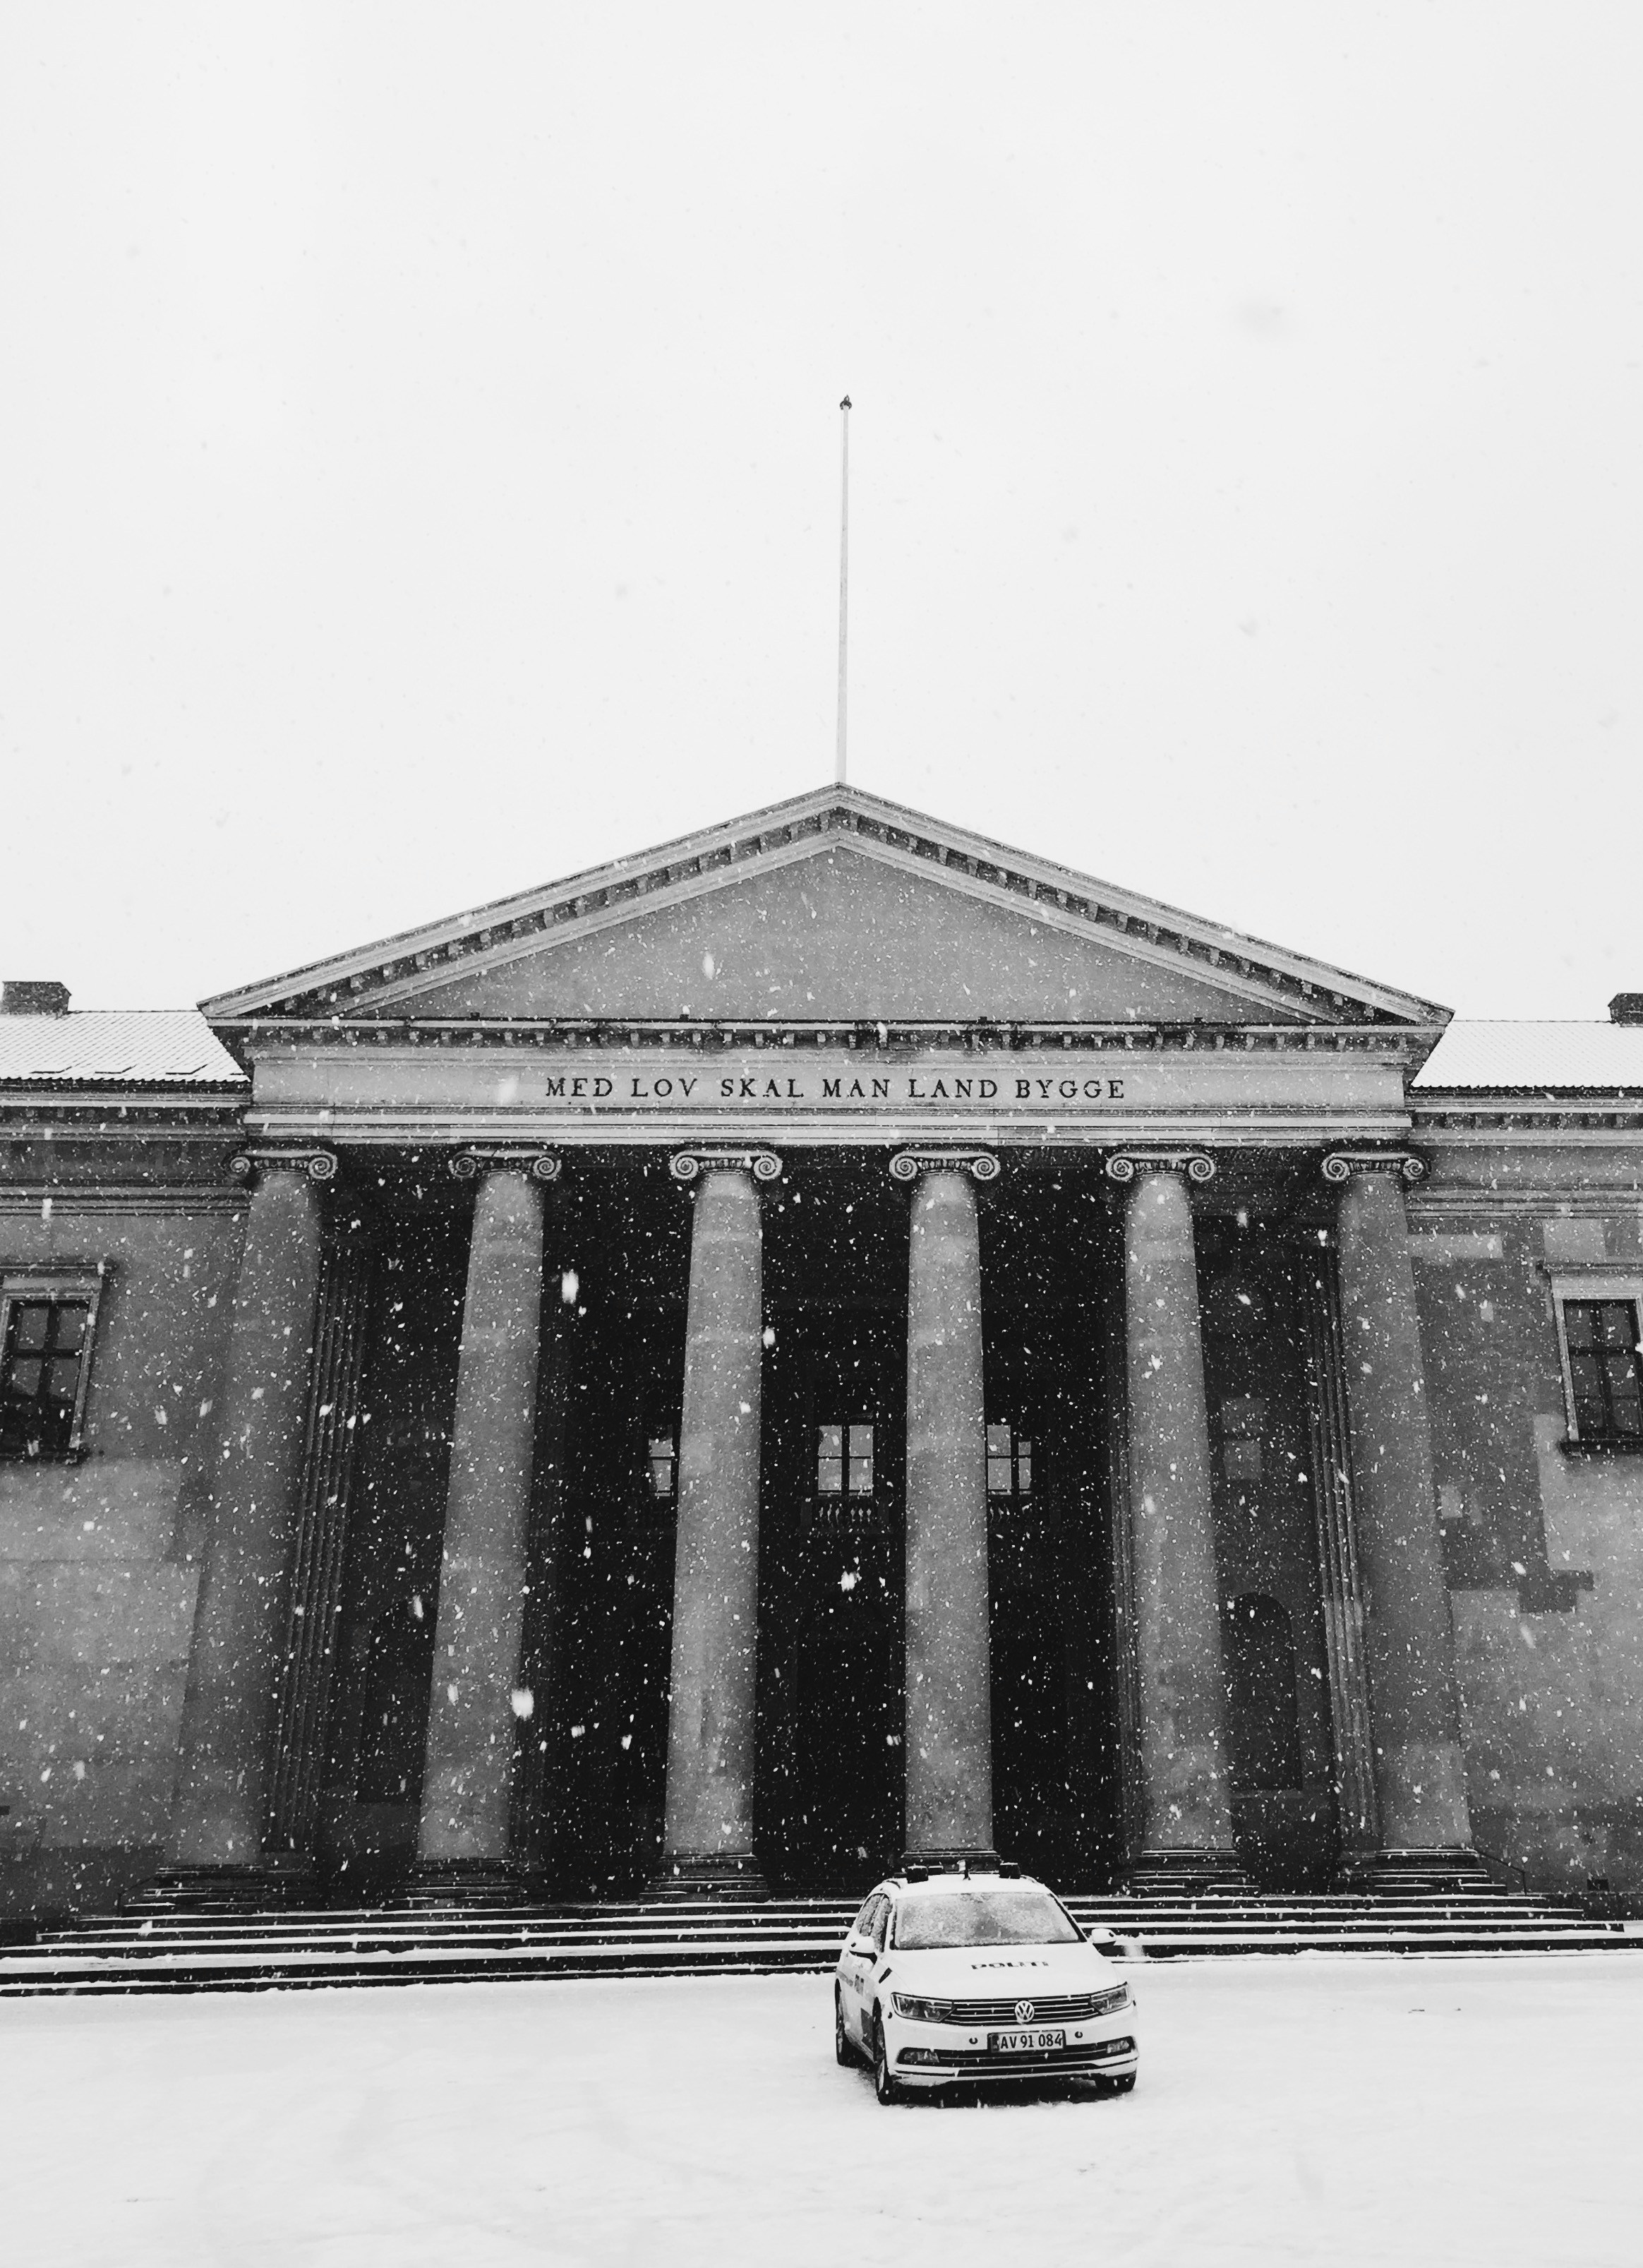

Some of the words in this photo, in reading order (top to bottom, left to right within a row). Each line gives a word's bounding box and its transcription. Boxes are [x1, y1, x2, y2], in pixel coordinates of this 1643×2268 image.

[546, 1077, 613, 1097] MED
[631, 1078, 697, 1098] LOV
[721, 1078, 804, 1098] SKAL
[822, 1079, 890, 1098] MAN
[908, 1079, 998, 1098] LAND
[1015, 1079, 1124, 1099] BYGGE
[971, 1961, 1049, 1969] POLITI
[1001, 2036, 1017, 2048] AV
[1020, 2034, 1034, 2048] 91
[1038, 2033, 1063, 2047] 084
